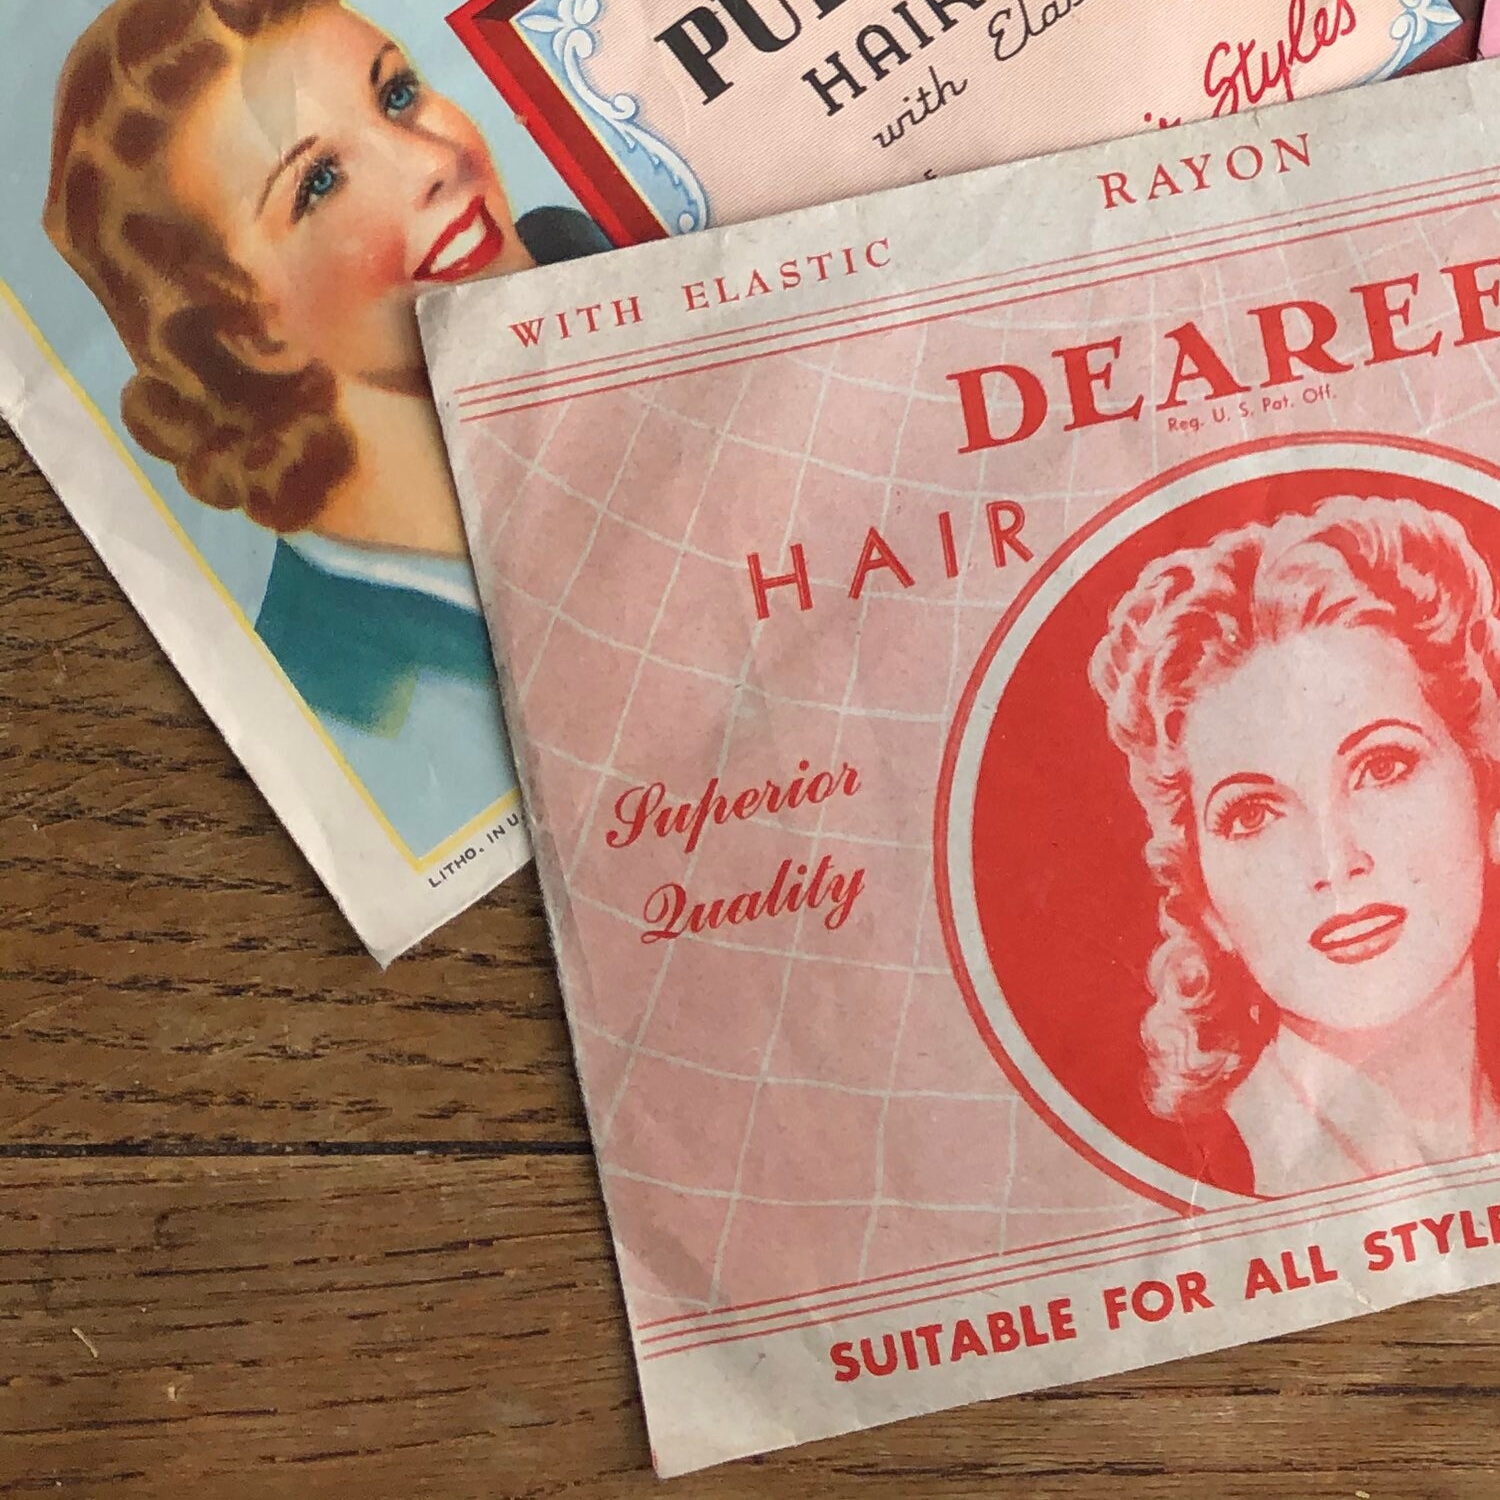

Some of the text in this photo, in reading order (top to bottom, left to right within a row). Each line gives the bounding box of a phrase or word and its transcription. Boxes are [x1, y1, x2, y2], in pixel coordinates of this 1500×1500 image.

[873, 67, 969, 150] with
[1098, 132, 1315, 208] RAYON
[510, 237, 894, 349] WITH ELASTIC
[1167, 417, 1204, 432] Reg.
[1262, 395, 1294, 412] Pat.
[1302, 384, 1337, 404] Off.
[746, 499, 1035, 621] HAIR
[606, 759, 862, 854] Superior
[428, 847, 484, 888] LITHO.
[486, 825, 506, 844] IN
[640, 854, 866, 946] Quality
[829, 1297, 1077, 1385] SUITABLE
[1103, 1271, 1213, 1333] FOR
[1243, 1247, 1339, 1303] ALL
